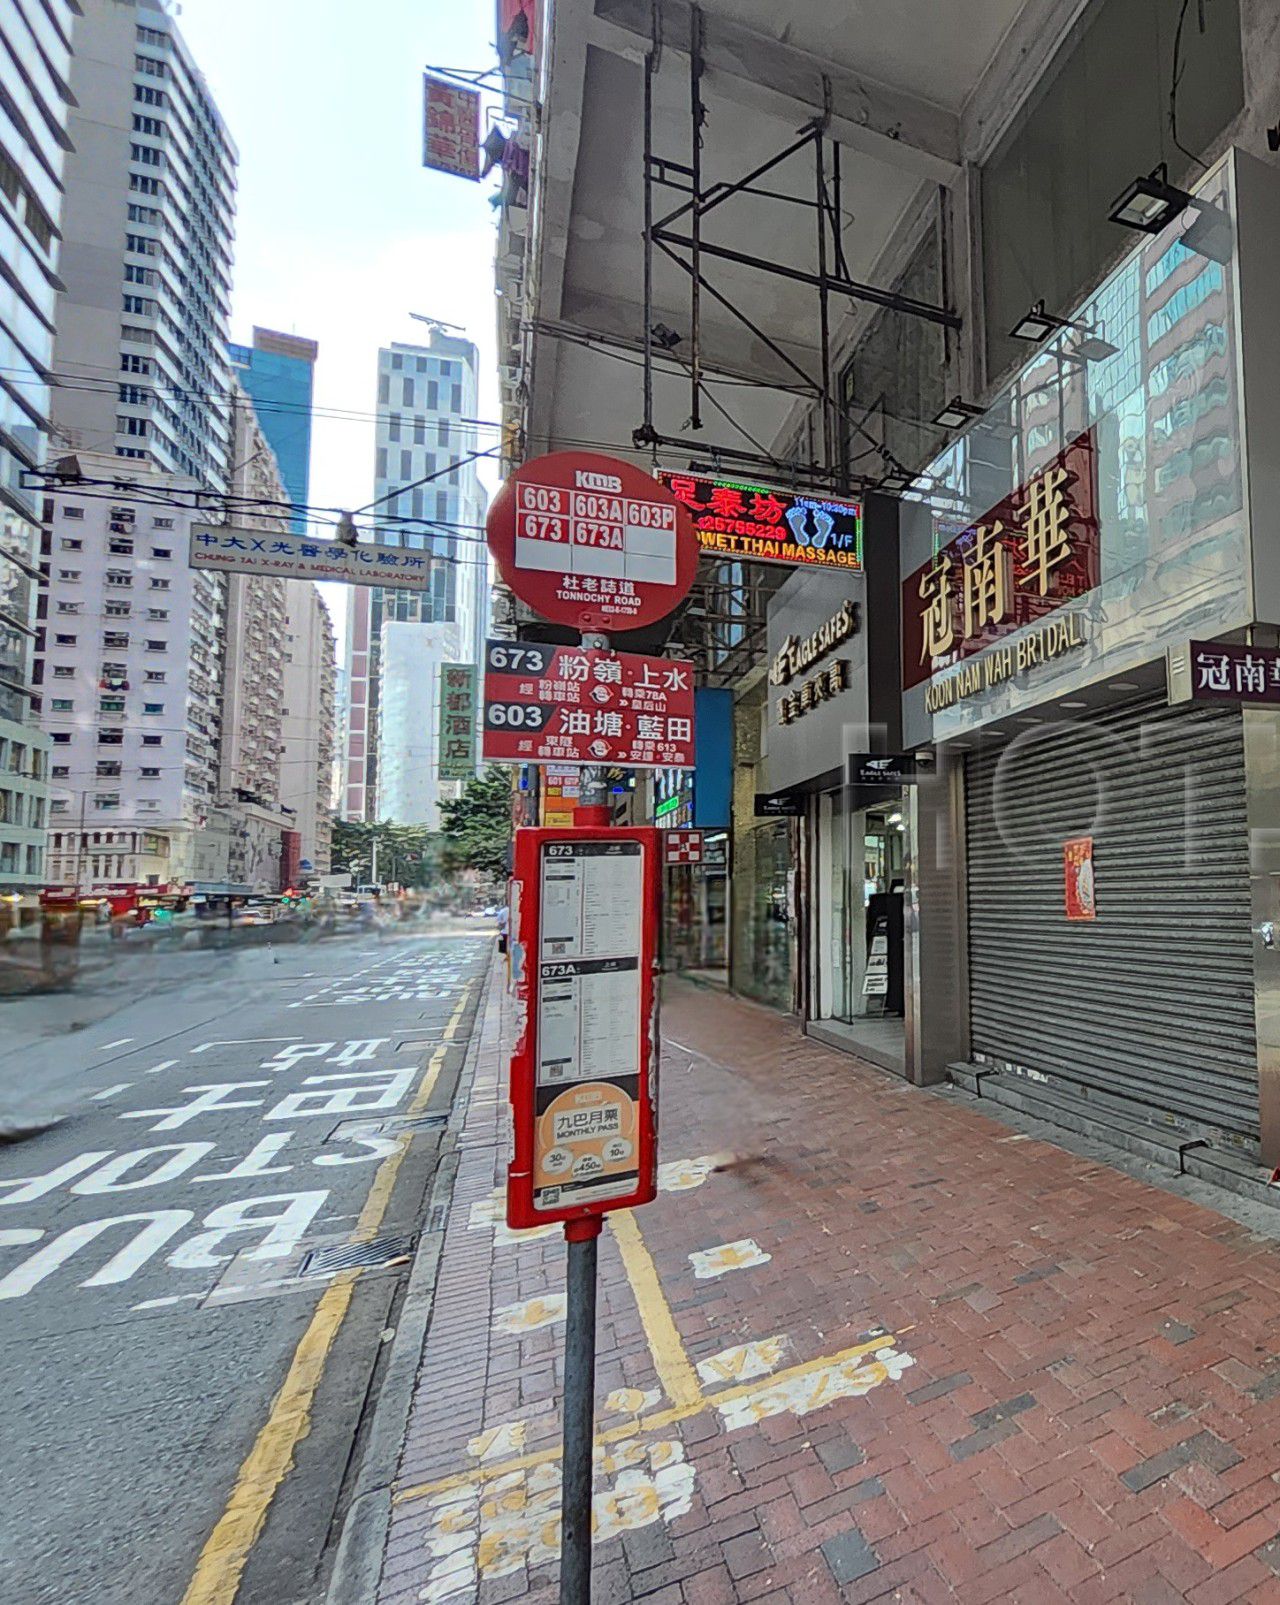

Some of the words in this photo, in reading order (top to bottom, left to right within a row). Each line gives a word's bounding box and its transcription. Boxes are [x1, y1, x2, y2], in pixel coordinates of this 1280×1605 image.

[575, 470, 622, 494] KMB
[523, 487, 561, 513] 603
[575, 495, 622, 521] 603A
[629, 503, 673, 529] 603P
[524, 515, 562, 541] 673
[576, 522, 623, 549] 673A
[830, 533, 853, 548] 1/F
[740, 536, 779, 555] THAI
[782, 543, 856, 565] MASSAGE
[194, 551, 236, 564] CHUNG
[261, 557, 294, 569] X-RAY
[311, 563, 356, 576] MEDICAL
[359, 568, 425, 582] LABORATORY
[918, 467, 1072, 664] 冠南華
[562, 575, 635, 596] 杜老誌道
[555, 590, 610, 604] TONNOCHY
[614, 595, 642, 607] ROAD
[490, 647, 544, 671] 673
[787, 630, 817, 675] EAGLE
[924, 675, 953, 714] KOON
[956, 661, 981, 699] NAM
[984, 646, 1012, 686] WAH
[1016, 612, 1082, 671] BRIDAL
[488, 703, 543, 727] 603
[656, 740, 677, 752] 613
[549, 845, 573, 856] 673
[541, 964, 576, 977] 673A
[556, 1126, 597, 1139] MONTHLY
[597, 1122, 619, 1133] PASS
[0, 1190, 330, 1299] BU
